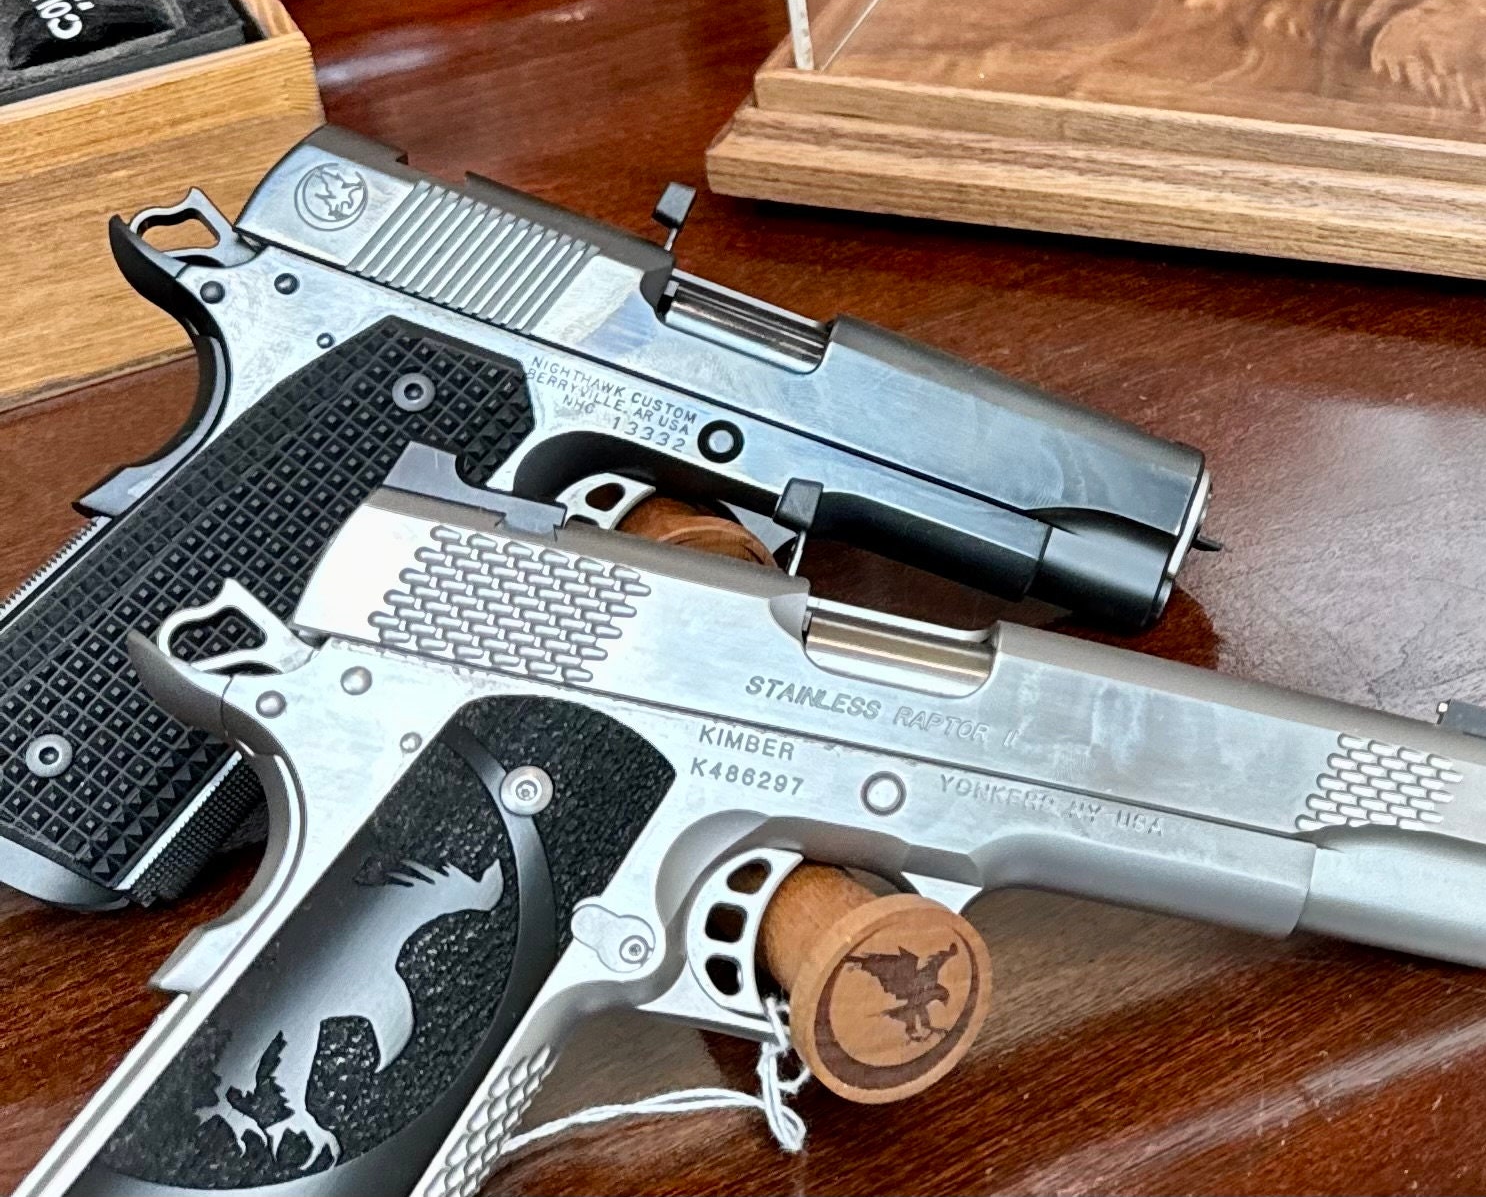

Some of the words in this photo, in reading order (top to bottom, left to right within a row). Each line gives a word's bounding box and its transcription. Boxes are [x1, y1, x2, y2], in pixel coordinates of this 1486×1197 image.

[531, 355, 625, 399] NIGHTHAWK
[631, 392, 698, 425] CUSTOM
[611, 416, 687, 452] 13332
[633, 406, 655, 423] AR
[657, 414, 690, 436] USA
[744, 674, 882, 721] STAINLESS
[892, 705, 989, 742] RAPTOR
[698, 725, 796, 761] KIMBER
[690, 756, 805, 797] K486297
[1117, 809, 1166, 839] USA
